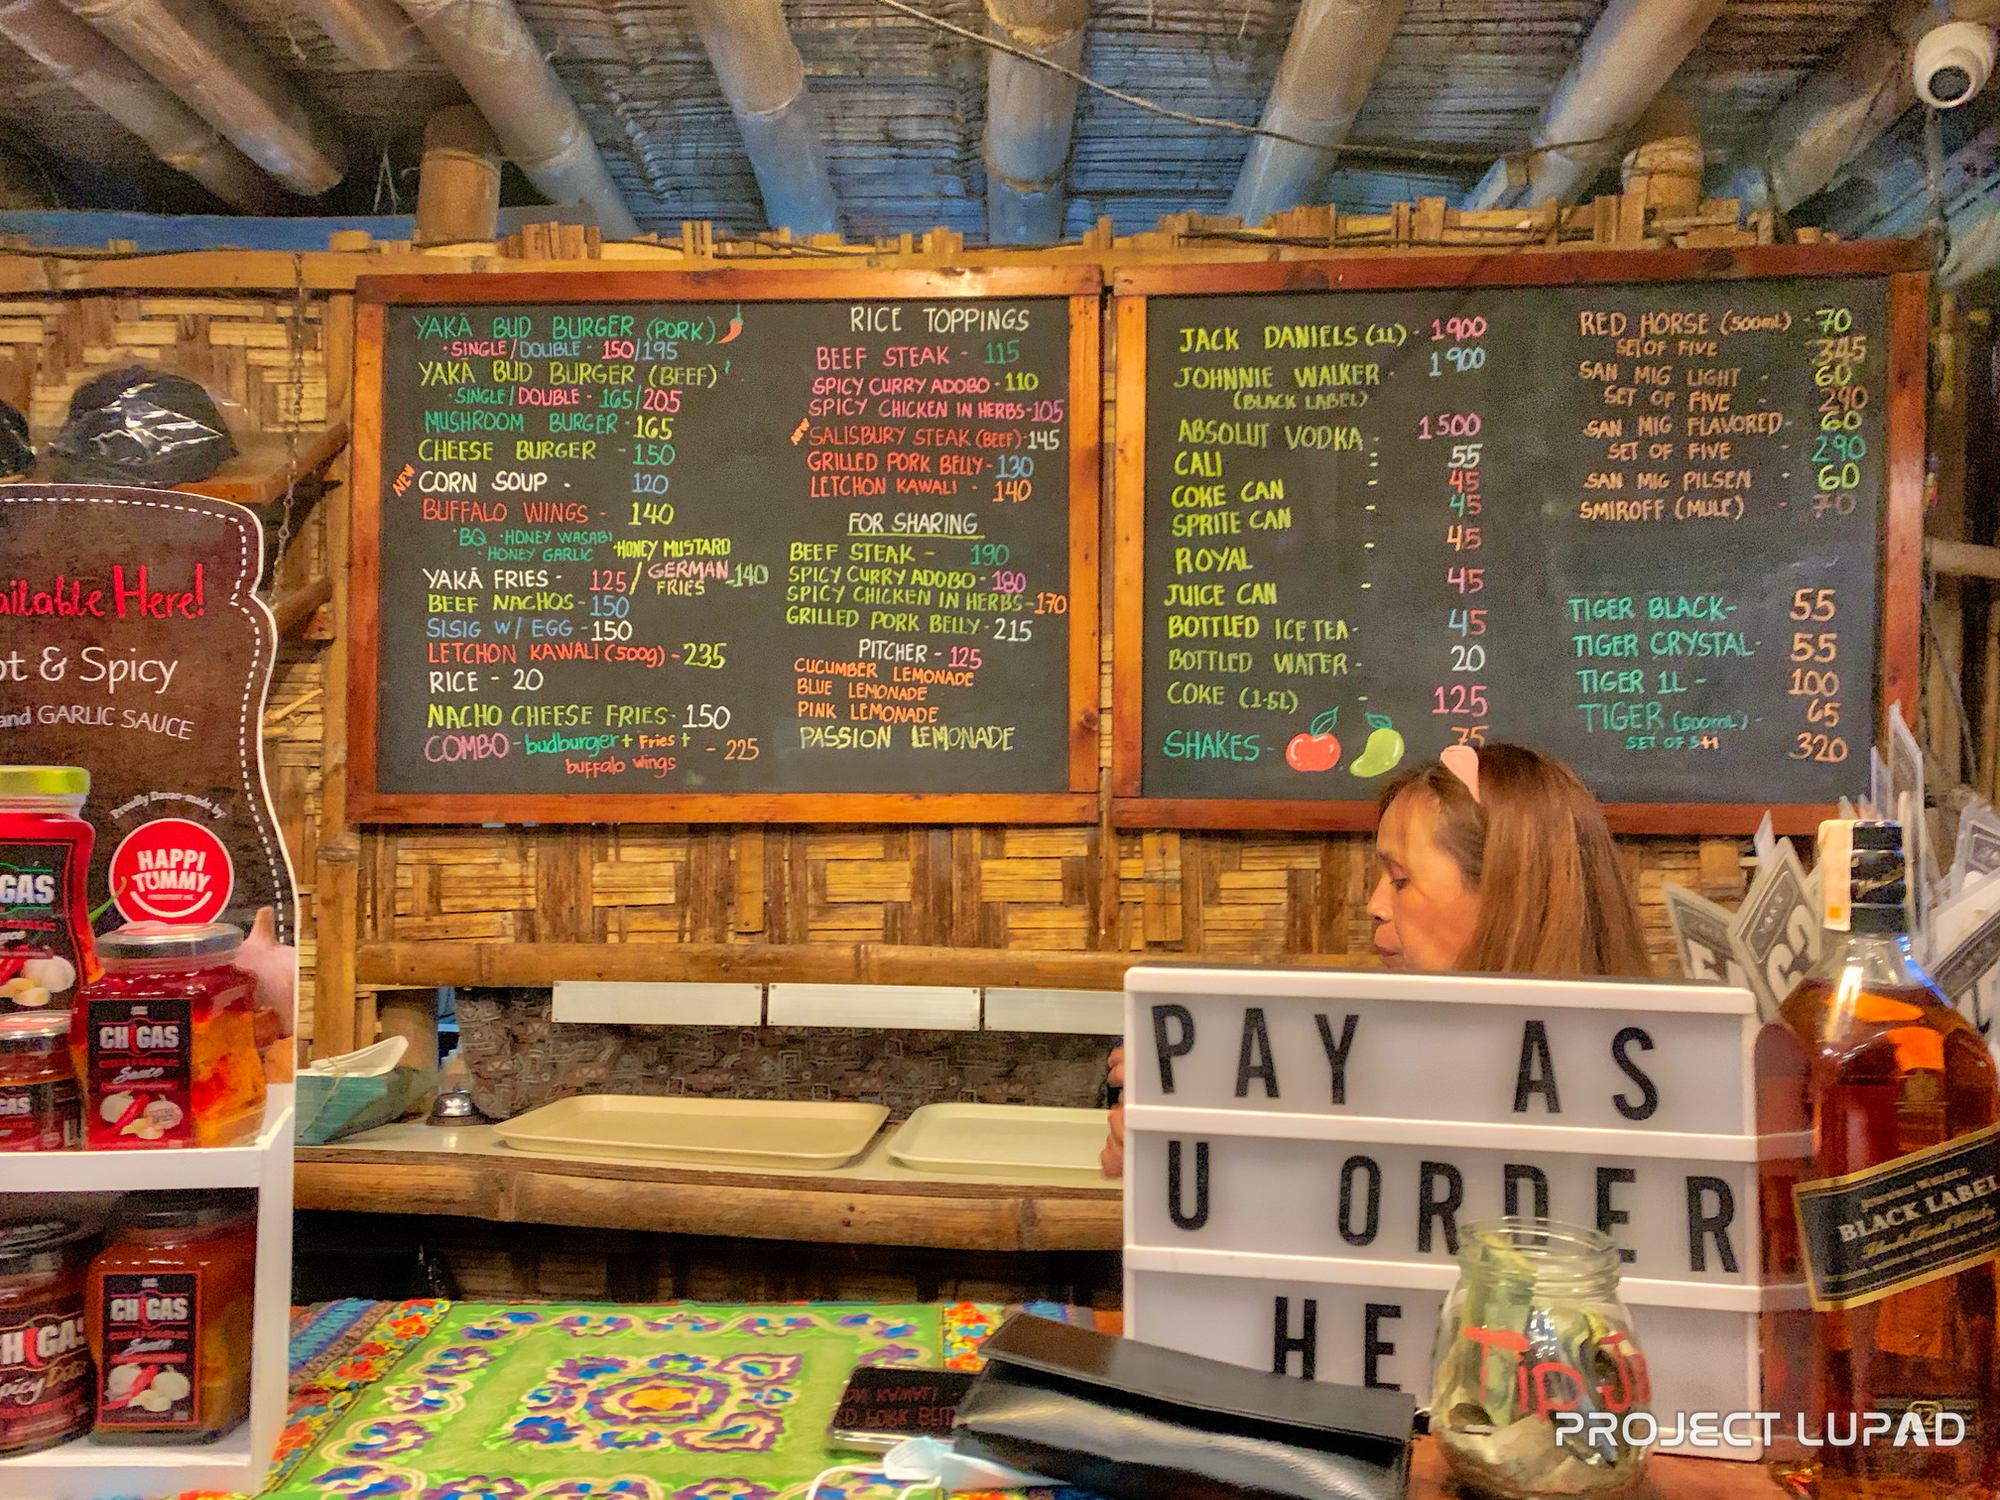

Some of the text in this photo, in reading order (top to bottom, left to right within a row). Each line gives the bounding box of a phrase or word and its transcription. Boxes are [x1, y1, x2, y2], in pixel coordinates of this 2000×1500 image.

[492, 316, 716, 343] BUD BURGER (PORK)
[850, 306, 1030, 332] RICE TOPPINGS
[1580, 308, 1852, 337] RED HORSE 70
[1179, 328, 1239, 353] JACK
[1264, 325, 1358, 349] DANIELS
[1431, 316, 1488, 342] 1900
[816, 340, 1020, 370] BEEF STEAK 115
[1173, 347, 1486, 389] JOHNNIE WALKER 1900
[492, 360, 718, 388] BUD BURGER (BEEF)
[1579, 360, 1851, 387] SAN MIG LIGHT 60
[808, 398, 1064, 422] SPICY CHICKEN IN HERBS 105
[809, 426, 906, 446] SALISBURY
[912, 428, 977, 446] STEAK
[976, 430, 1022, 450] (BEEF)
[1028, 430, 1060, 450] 145
[1178, 414, 1481, 451] ABSOLUT VODKA 1500
[418, 439, 676, 466] CHEESE BURGER 150
[1174, 443, 1483, 477] CALI 55
[418, 471, 668, 494] CORN SOUP 120
[1171, 470, 1480, 509] COKE CAN 45
[1584, 462, 1861, 491] SAN MIG PILSEN 60
[422, 500, 674, 526] BUFFALO WINGS 140
[1674, 495, 1745, 520] (MULE)
[505, 529, 551, 545] HONEY
[557, 531, 613, 544] WASABI
[848, 512, 978, 534] FOR SHARING
[488, 546, 593, 562] HONEY GARLIC
[617, 538, 731, 561] HONEY MUSTARD
[1175, 522, 1483, 575] ROYAL 45
[494, 560, 769, 588] FRIES GERMAN 140
[657, 581, 705, 596] FRIES
[788, 566, 1026, 594] SPICY CURRY ADOBO 180
[113, 563, 204, 619] Here!
[427, 593, 630, 618] BEEF NACHOS 150
[1568, 588, 1836, 622] TIGER BLACK 55
[426, 618, 633, 642] SISIG EGG 150
[786, 606, 1033, 642] GRILLED PORK BELLY 215
[1168, 608, 1488, 641] BOTTLED ICE TEA 45
[427, 644, 516, 664] LETCHON
[531, 644, 599, 661] KAWALI
[683, 642, 727, 670] 235
[859, 638, 982, 670] PITCHER 125
[39, 646, 67, 682] &
[79, 647, 179, 694] Spicy
[430, 669, 544, 694] RICE 20
[794, 658, 974, 687] CUCUMBER LEMONADE
[1576, 669, 1645, 694] TIGER
[1788, 668, 1840, 697] 100
[1167, 682, 1488, 717] COKE 125
[37, 705, 115, 726] GARLIC
[121, 709, 195, 741] SAUCE
[427, 704, 731, 730] NACHO CHEESE FRIES 150
[1578, 699, 1841, 732] TIGER 65
[424, 733, 509, 762] COMBO
[724, 738, 760, 761] 225
[800, 725, 1016, 751] PASSION LEMONADE
[1163, 725, 1489, 762] SHAKES 75
[137, 848, 206, 871] HAPPI
[1151, 1004, 1659, 1122] PAY AS
[1168, 1141, 1211, 1231] U
[1337, 1153, 1739, 1273] ORDER
[1838, 1202, 1921, 1242] BLACK
